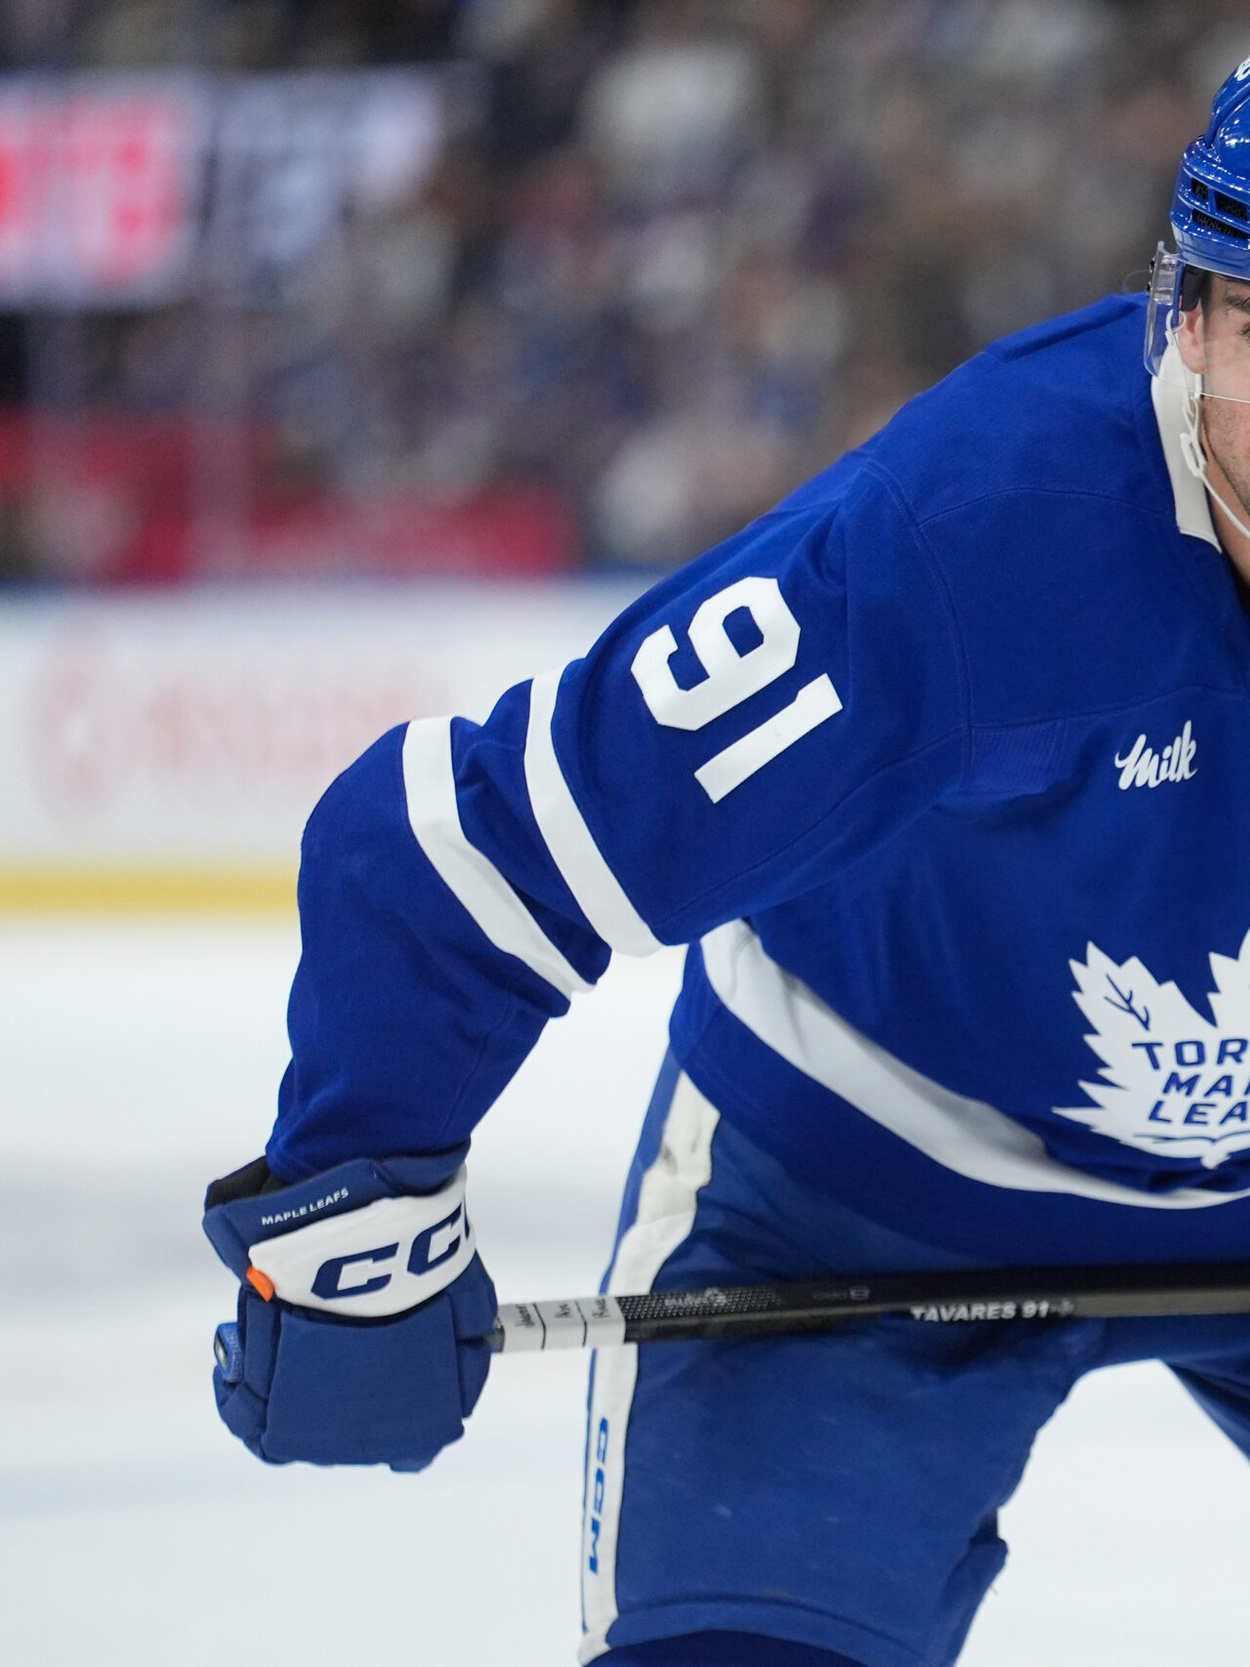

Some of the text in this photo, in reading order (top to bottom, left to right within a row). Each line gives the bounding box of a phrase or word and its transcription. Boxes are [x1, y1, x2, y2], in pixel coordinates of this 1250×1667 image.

[630, 576, 844, 804] 91
[1114, 720, 1198, 790] Milk
[261, 1187, 349, 1226] MAPLE LEAFS
[310, 1201, 470, 1300] CC
[909, 1299, 1051, 1323] TAVARES 91
[588, 1416, 609, 1576] CCM
